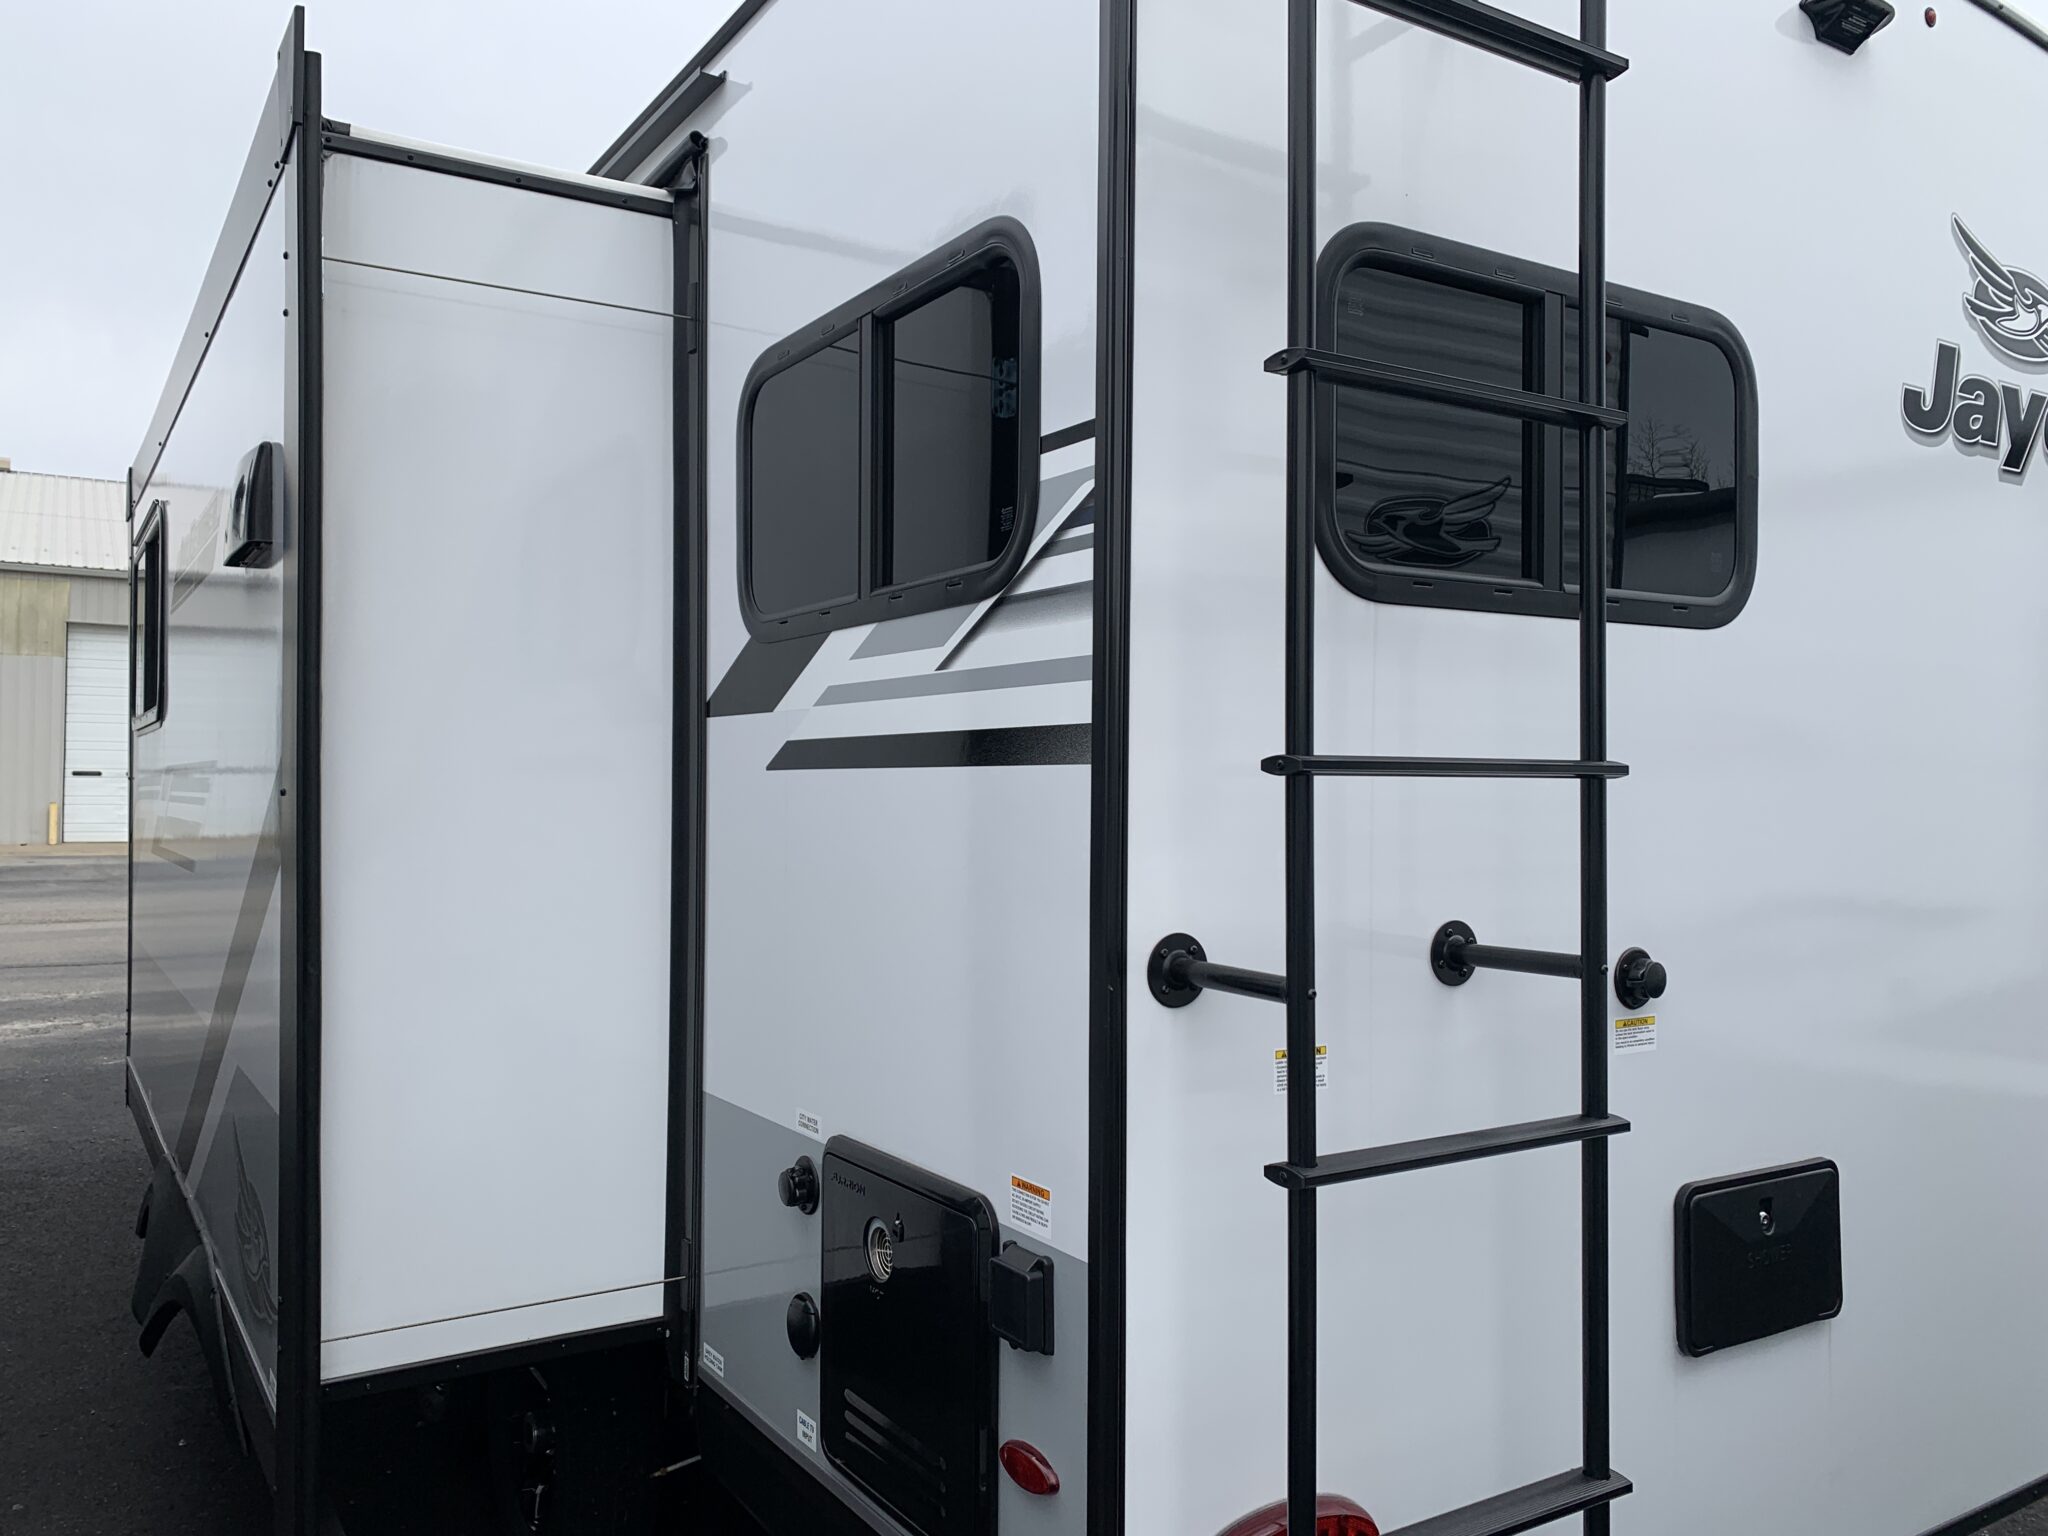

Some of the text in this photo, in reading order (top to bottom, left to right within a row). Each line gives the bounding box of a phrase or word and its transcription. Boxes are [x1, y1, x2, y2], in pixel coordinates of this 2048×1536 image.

[1902, 338, 2048, 473] Jay
[1626, 1018, 1648, 1027] CAUTION
[1022, 1181, 1045, 1198] WARNING
[1747, 1242, 1793, 1269] SHOWER
[799, 1416, 809, 1430] CABLE
